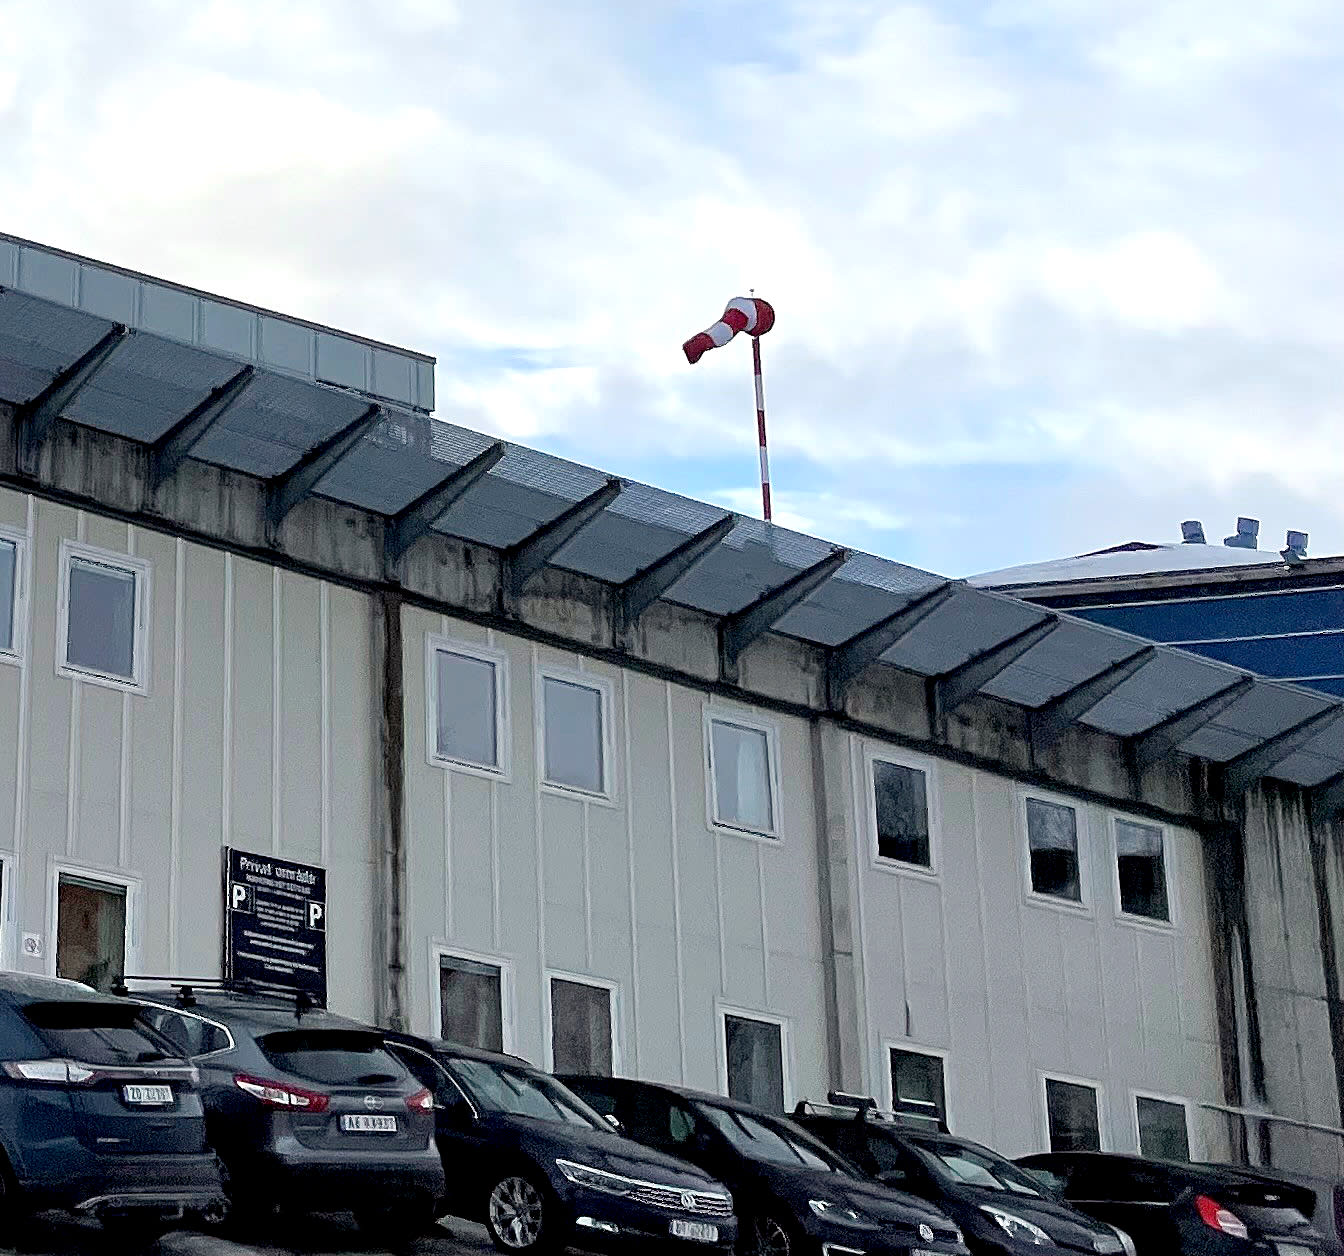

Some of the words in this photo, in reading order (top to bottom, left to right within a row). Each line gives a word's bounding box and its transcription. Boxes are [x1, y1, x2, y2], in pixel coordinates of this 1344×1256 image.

[239, 856, 273, 876] Privat
[232, 884, 246, 909] P
[309, 903, 323, 927] P
